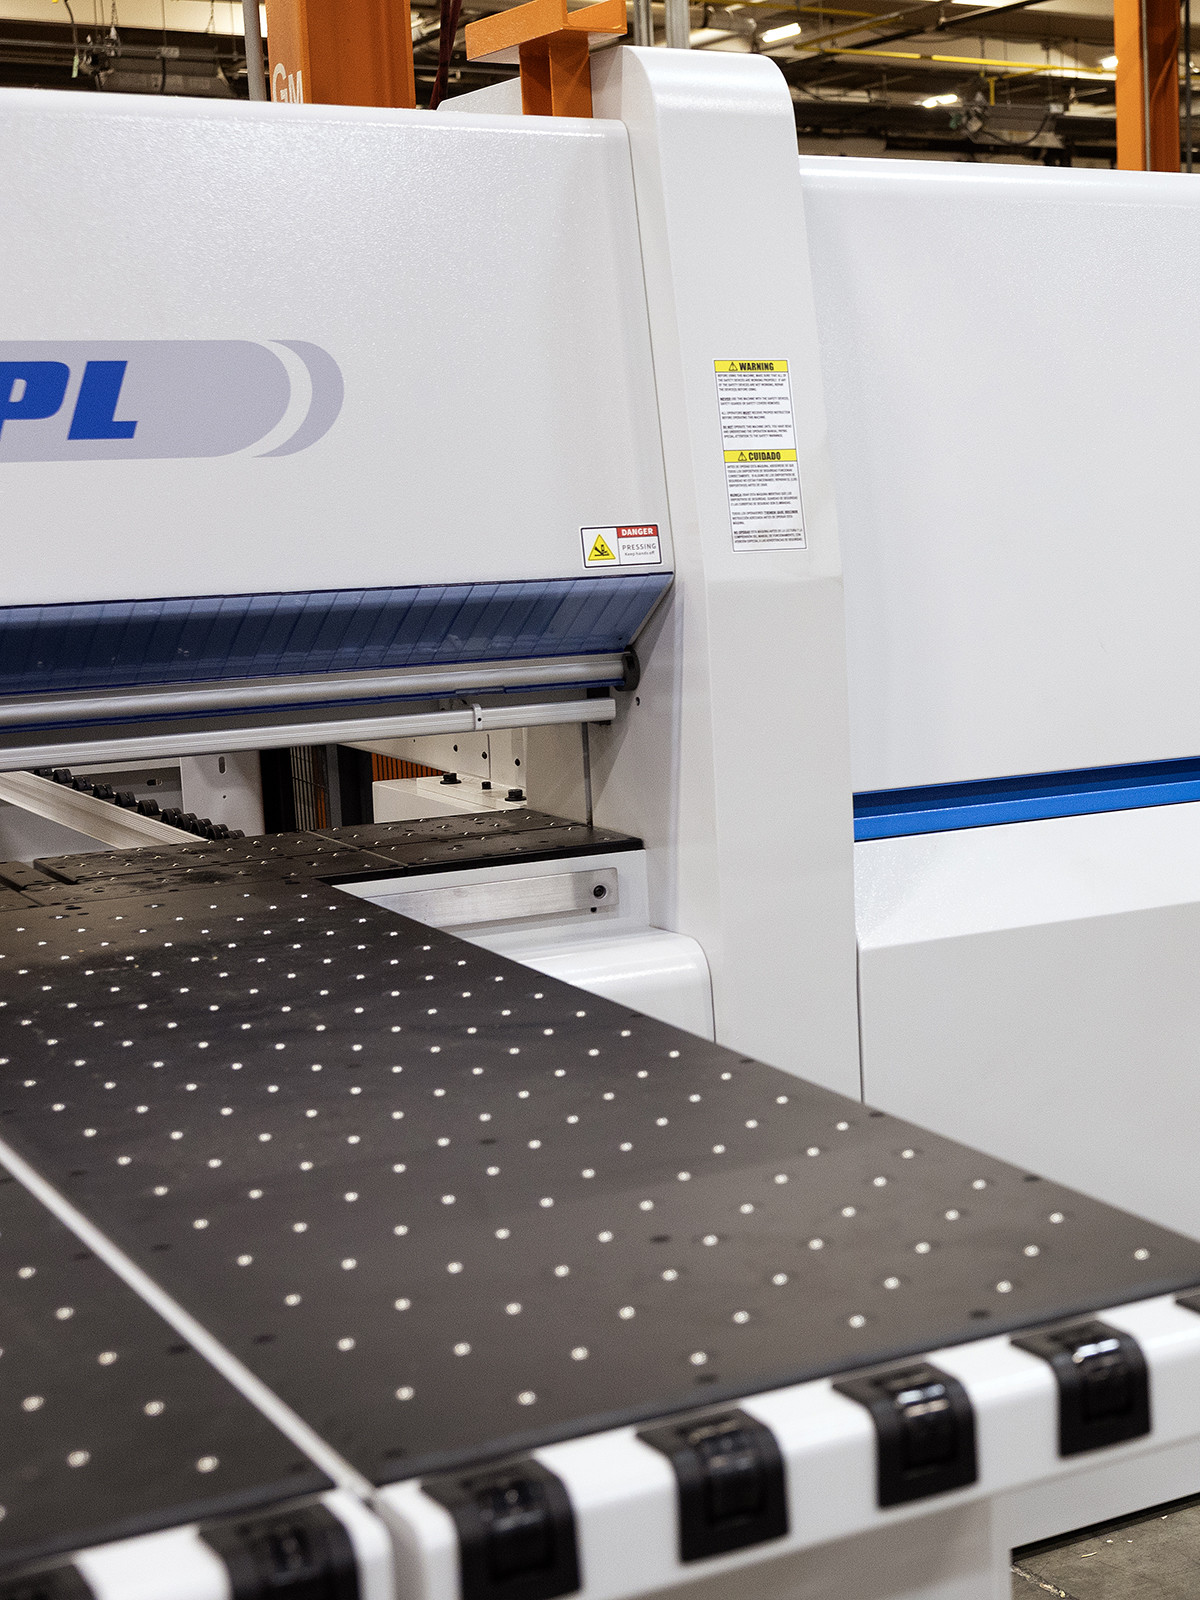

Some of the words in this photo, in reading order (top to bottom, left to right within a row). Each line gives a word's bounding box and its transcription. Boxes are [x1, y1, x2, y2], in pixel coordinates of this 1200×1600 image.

[739, 362, 774, 371] WARNING
[748, 451, 781, 461] CUIDADO
[621, 528, 653, 536] DANGER
